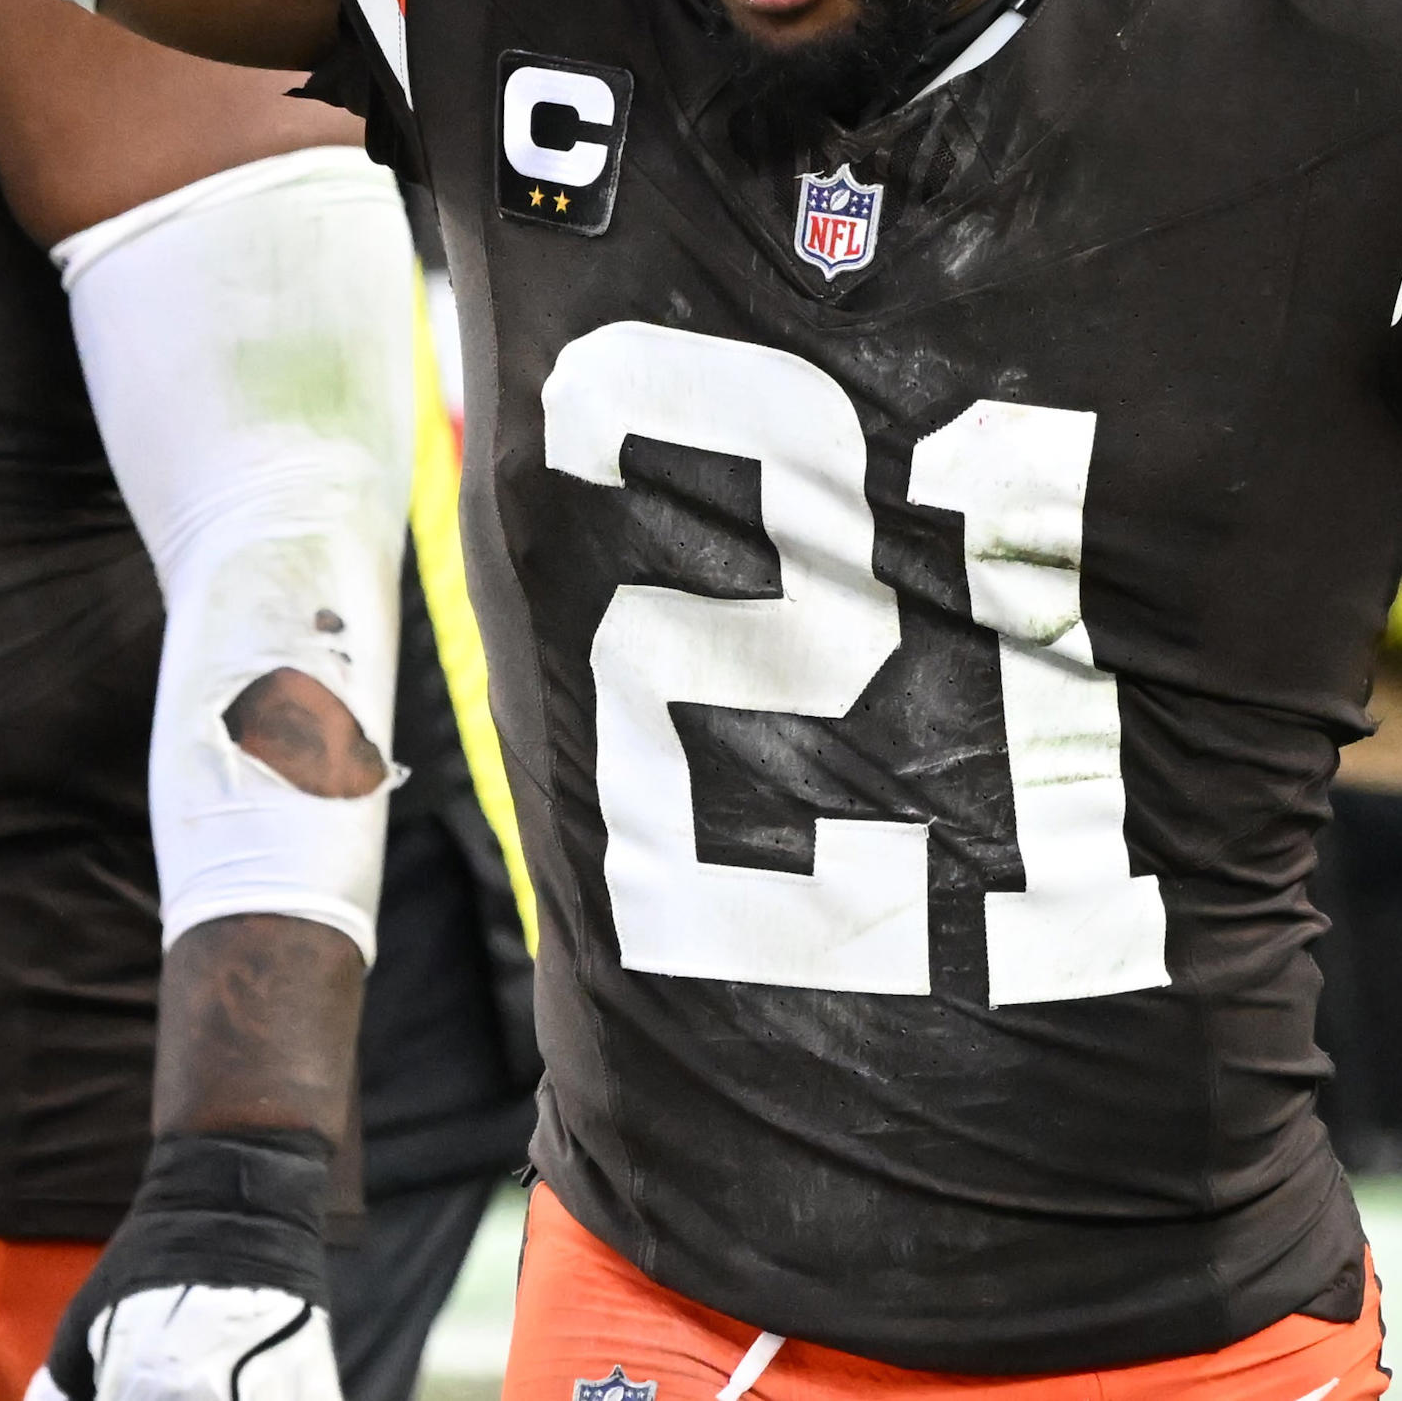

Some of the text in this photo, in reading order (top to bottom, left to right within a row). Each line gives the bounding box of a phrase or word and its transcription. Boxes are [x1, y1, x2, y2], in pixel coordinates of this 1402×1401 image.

[503, 66, 615, 188] C
[807, 215, 861, 259] NFL
[541, 320, 1172, 1008] 21
